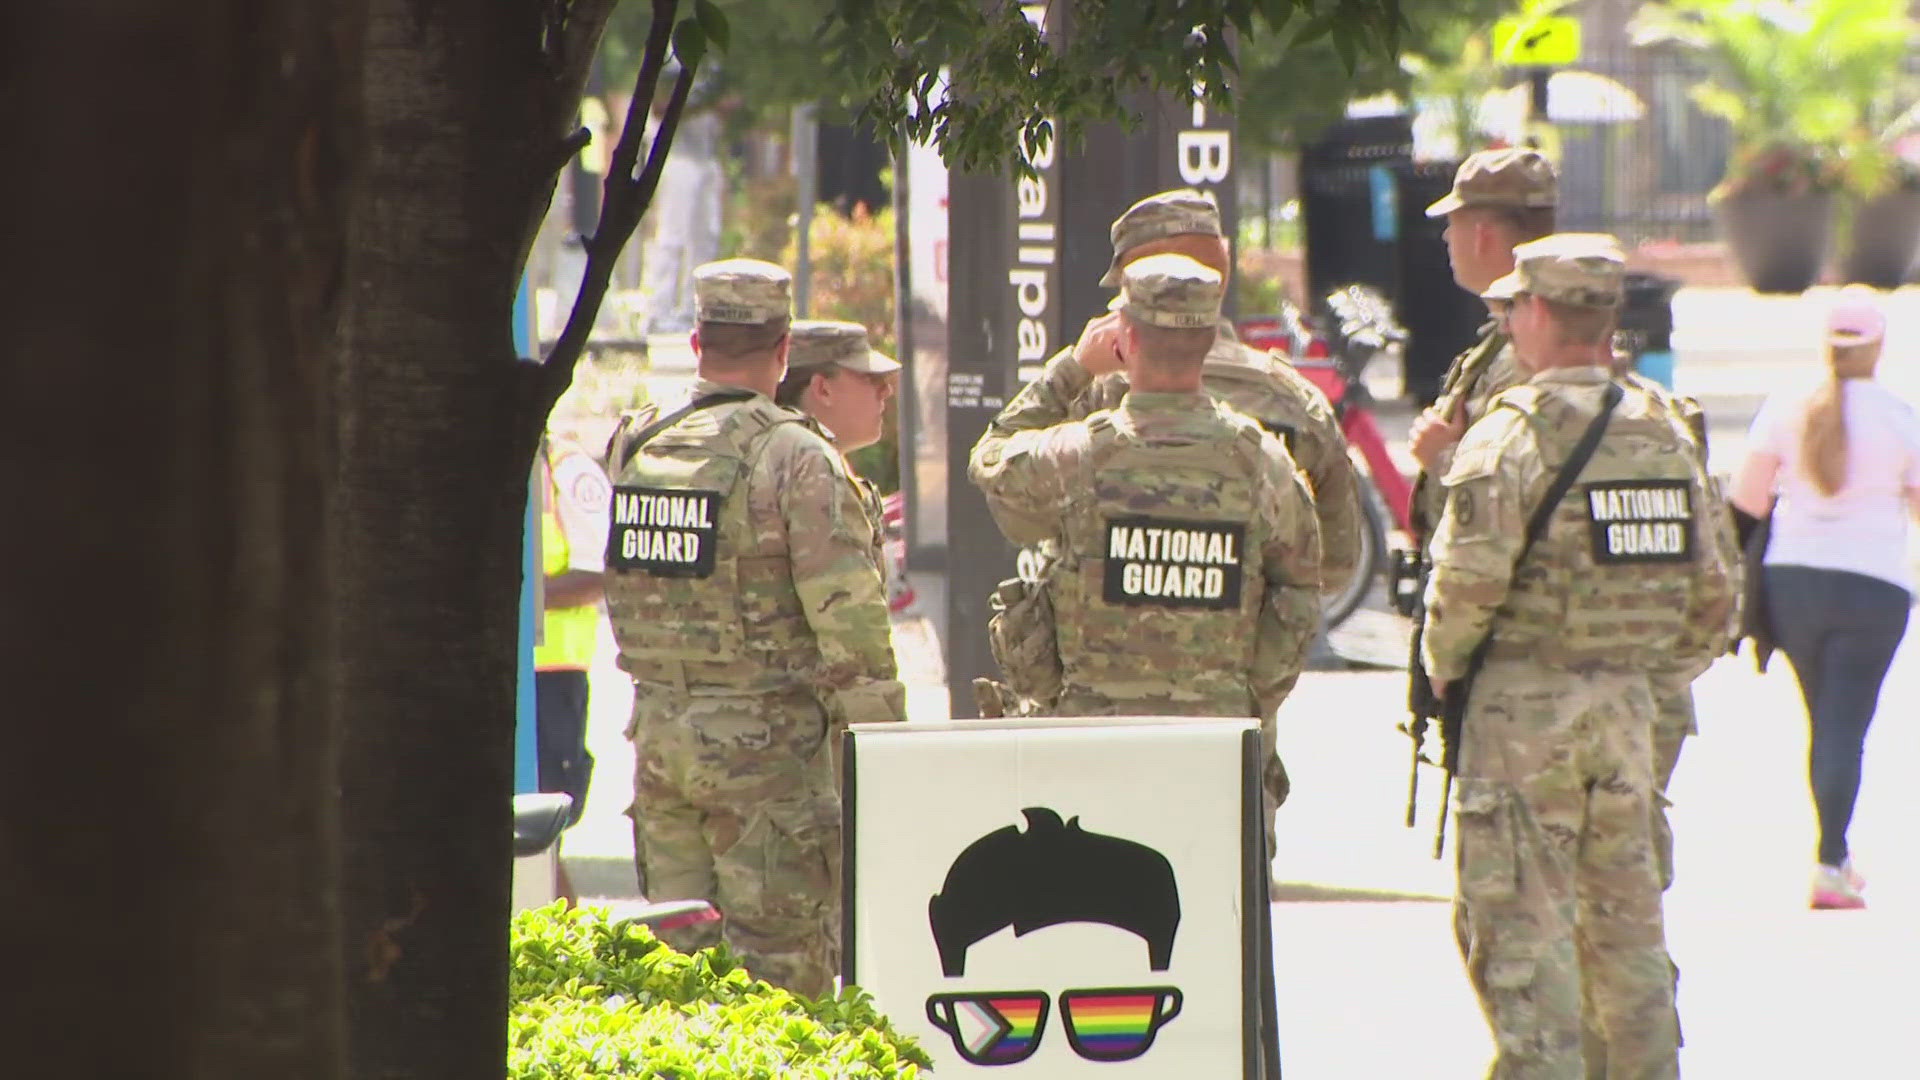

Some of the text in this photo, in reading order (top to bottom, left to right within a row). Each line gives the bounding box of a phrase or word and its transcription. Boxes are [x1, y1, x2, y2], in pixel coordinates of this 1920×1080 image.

[615, 494, 712, 529] NATIONAL
[1589, 488, 1691, 520] NATIONAL
[622, 529, 699, 562] GUARD
[1110, 527, 1238, 565] NATIONAL
[1607, 522, 1685, 555] GUARD
[1122, 563, 1223, 599] GUARD
